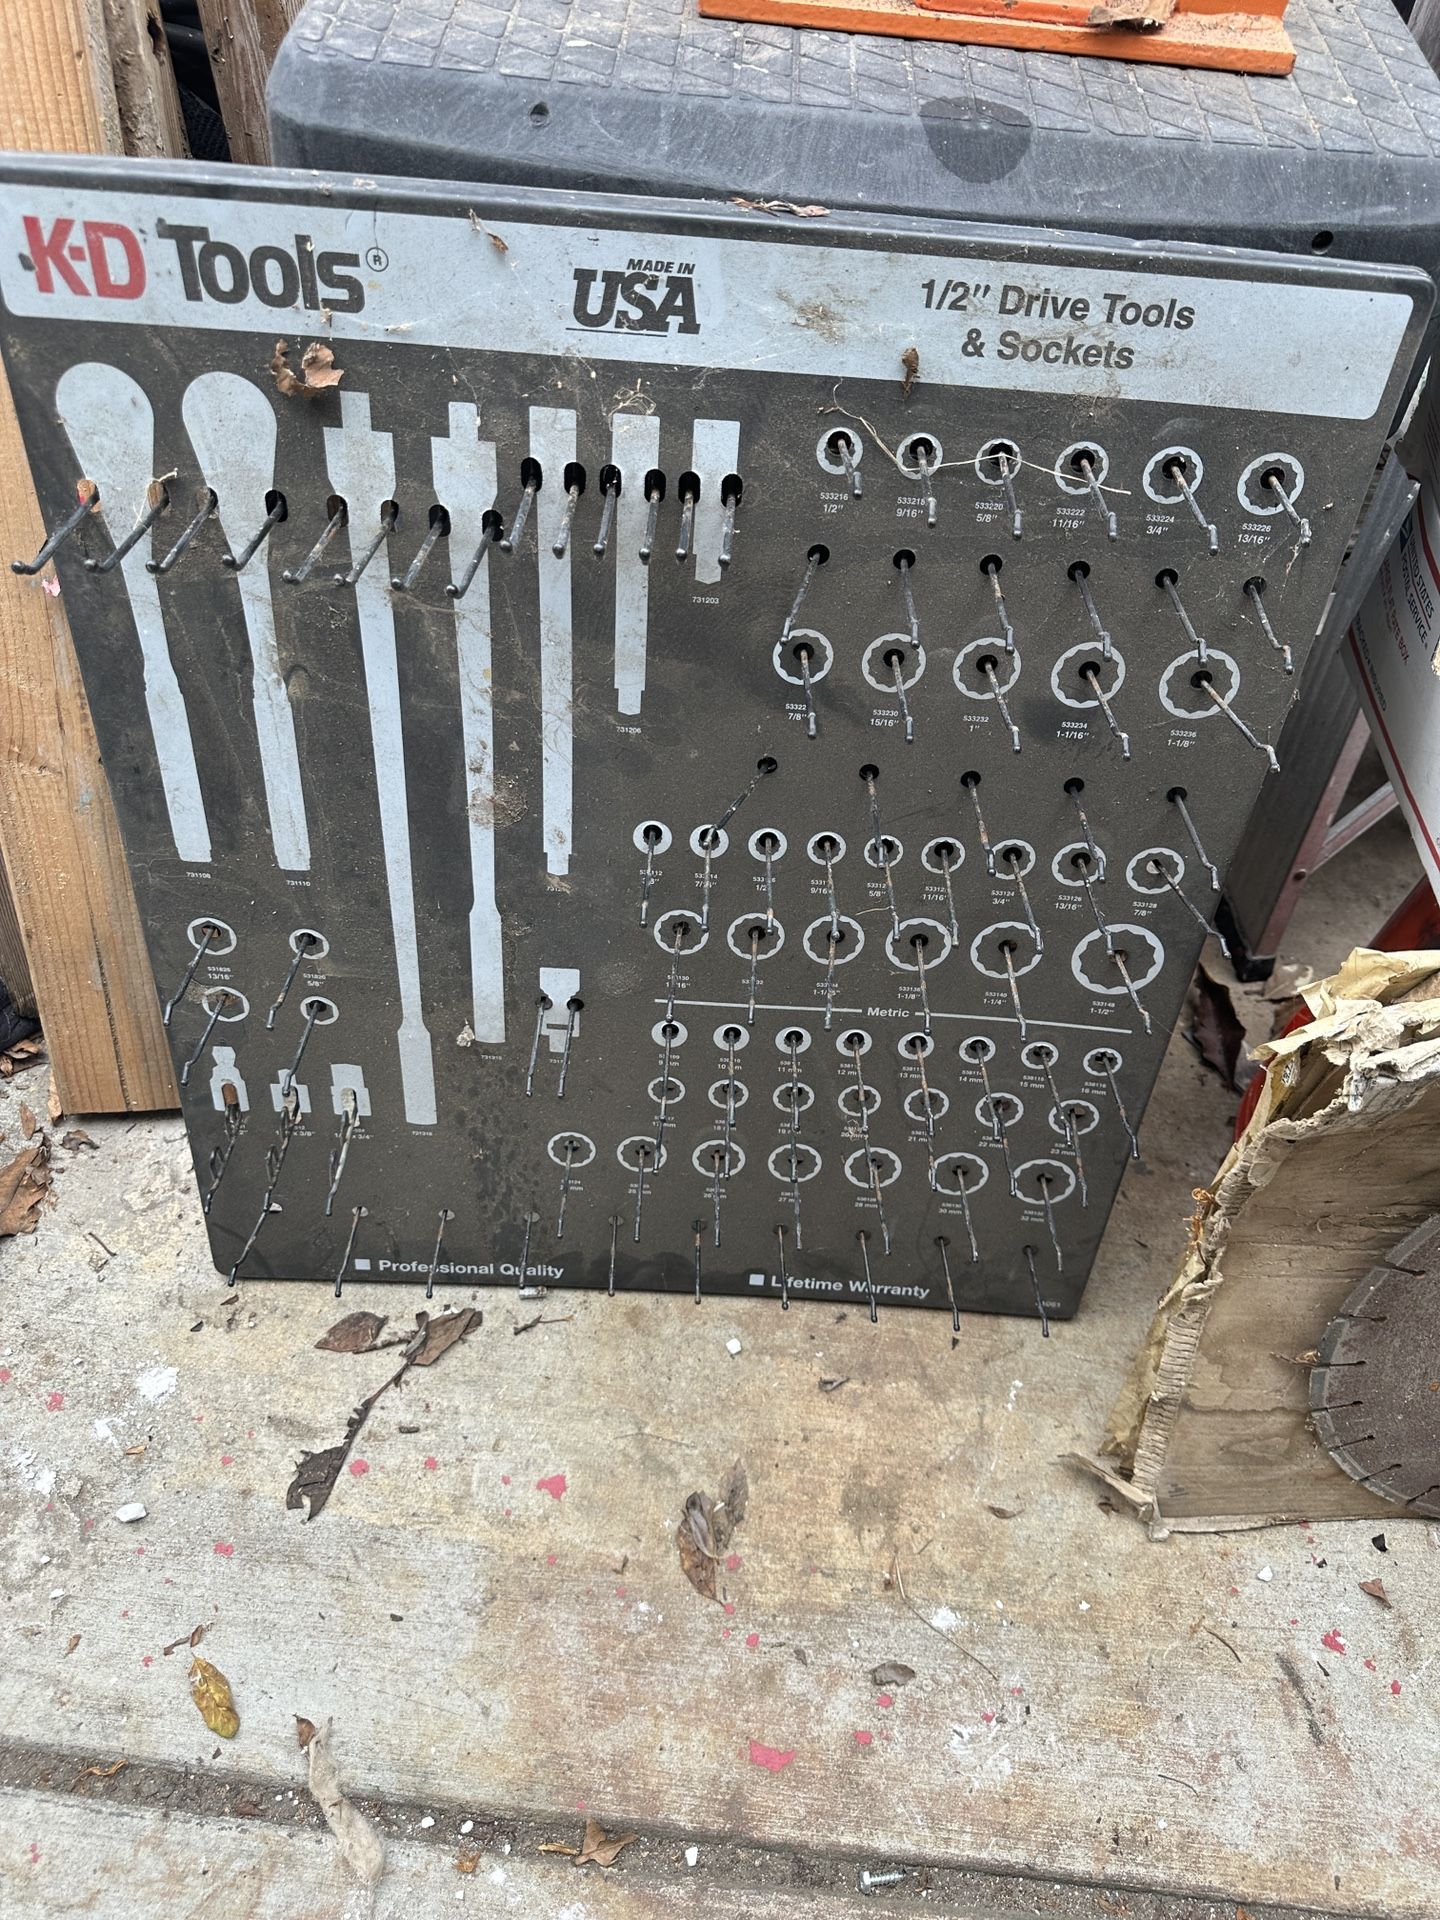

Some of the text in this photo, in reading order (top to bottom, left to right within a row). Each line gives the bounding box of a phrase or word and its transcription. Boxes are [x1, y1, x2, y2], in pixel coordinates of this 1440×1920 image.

[22, 215, 146, 300] K-D
[156, 217, 366, 313] Tools
[626, 258, 696, 275] MADE IN
[572, 268, 701, 335] USA
[999, 284, 1091, 321] Drive
[1103, 292, 1195, 330] Tools
[961, 328, 1135, 370] & Sockets
[1056, 507, 1085, 517] 533222
[1146, 514, 1175, 523] 533224
[1406, 594, 1428, 643] SERVICE
[1416, 576, 1435, 619] STATES
[867, 1007, 910, 1018] Metric
[771, 1275, 844, 1291] Lfetime
